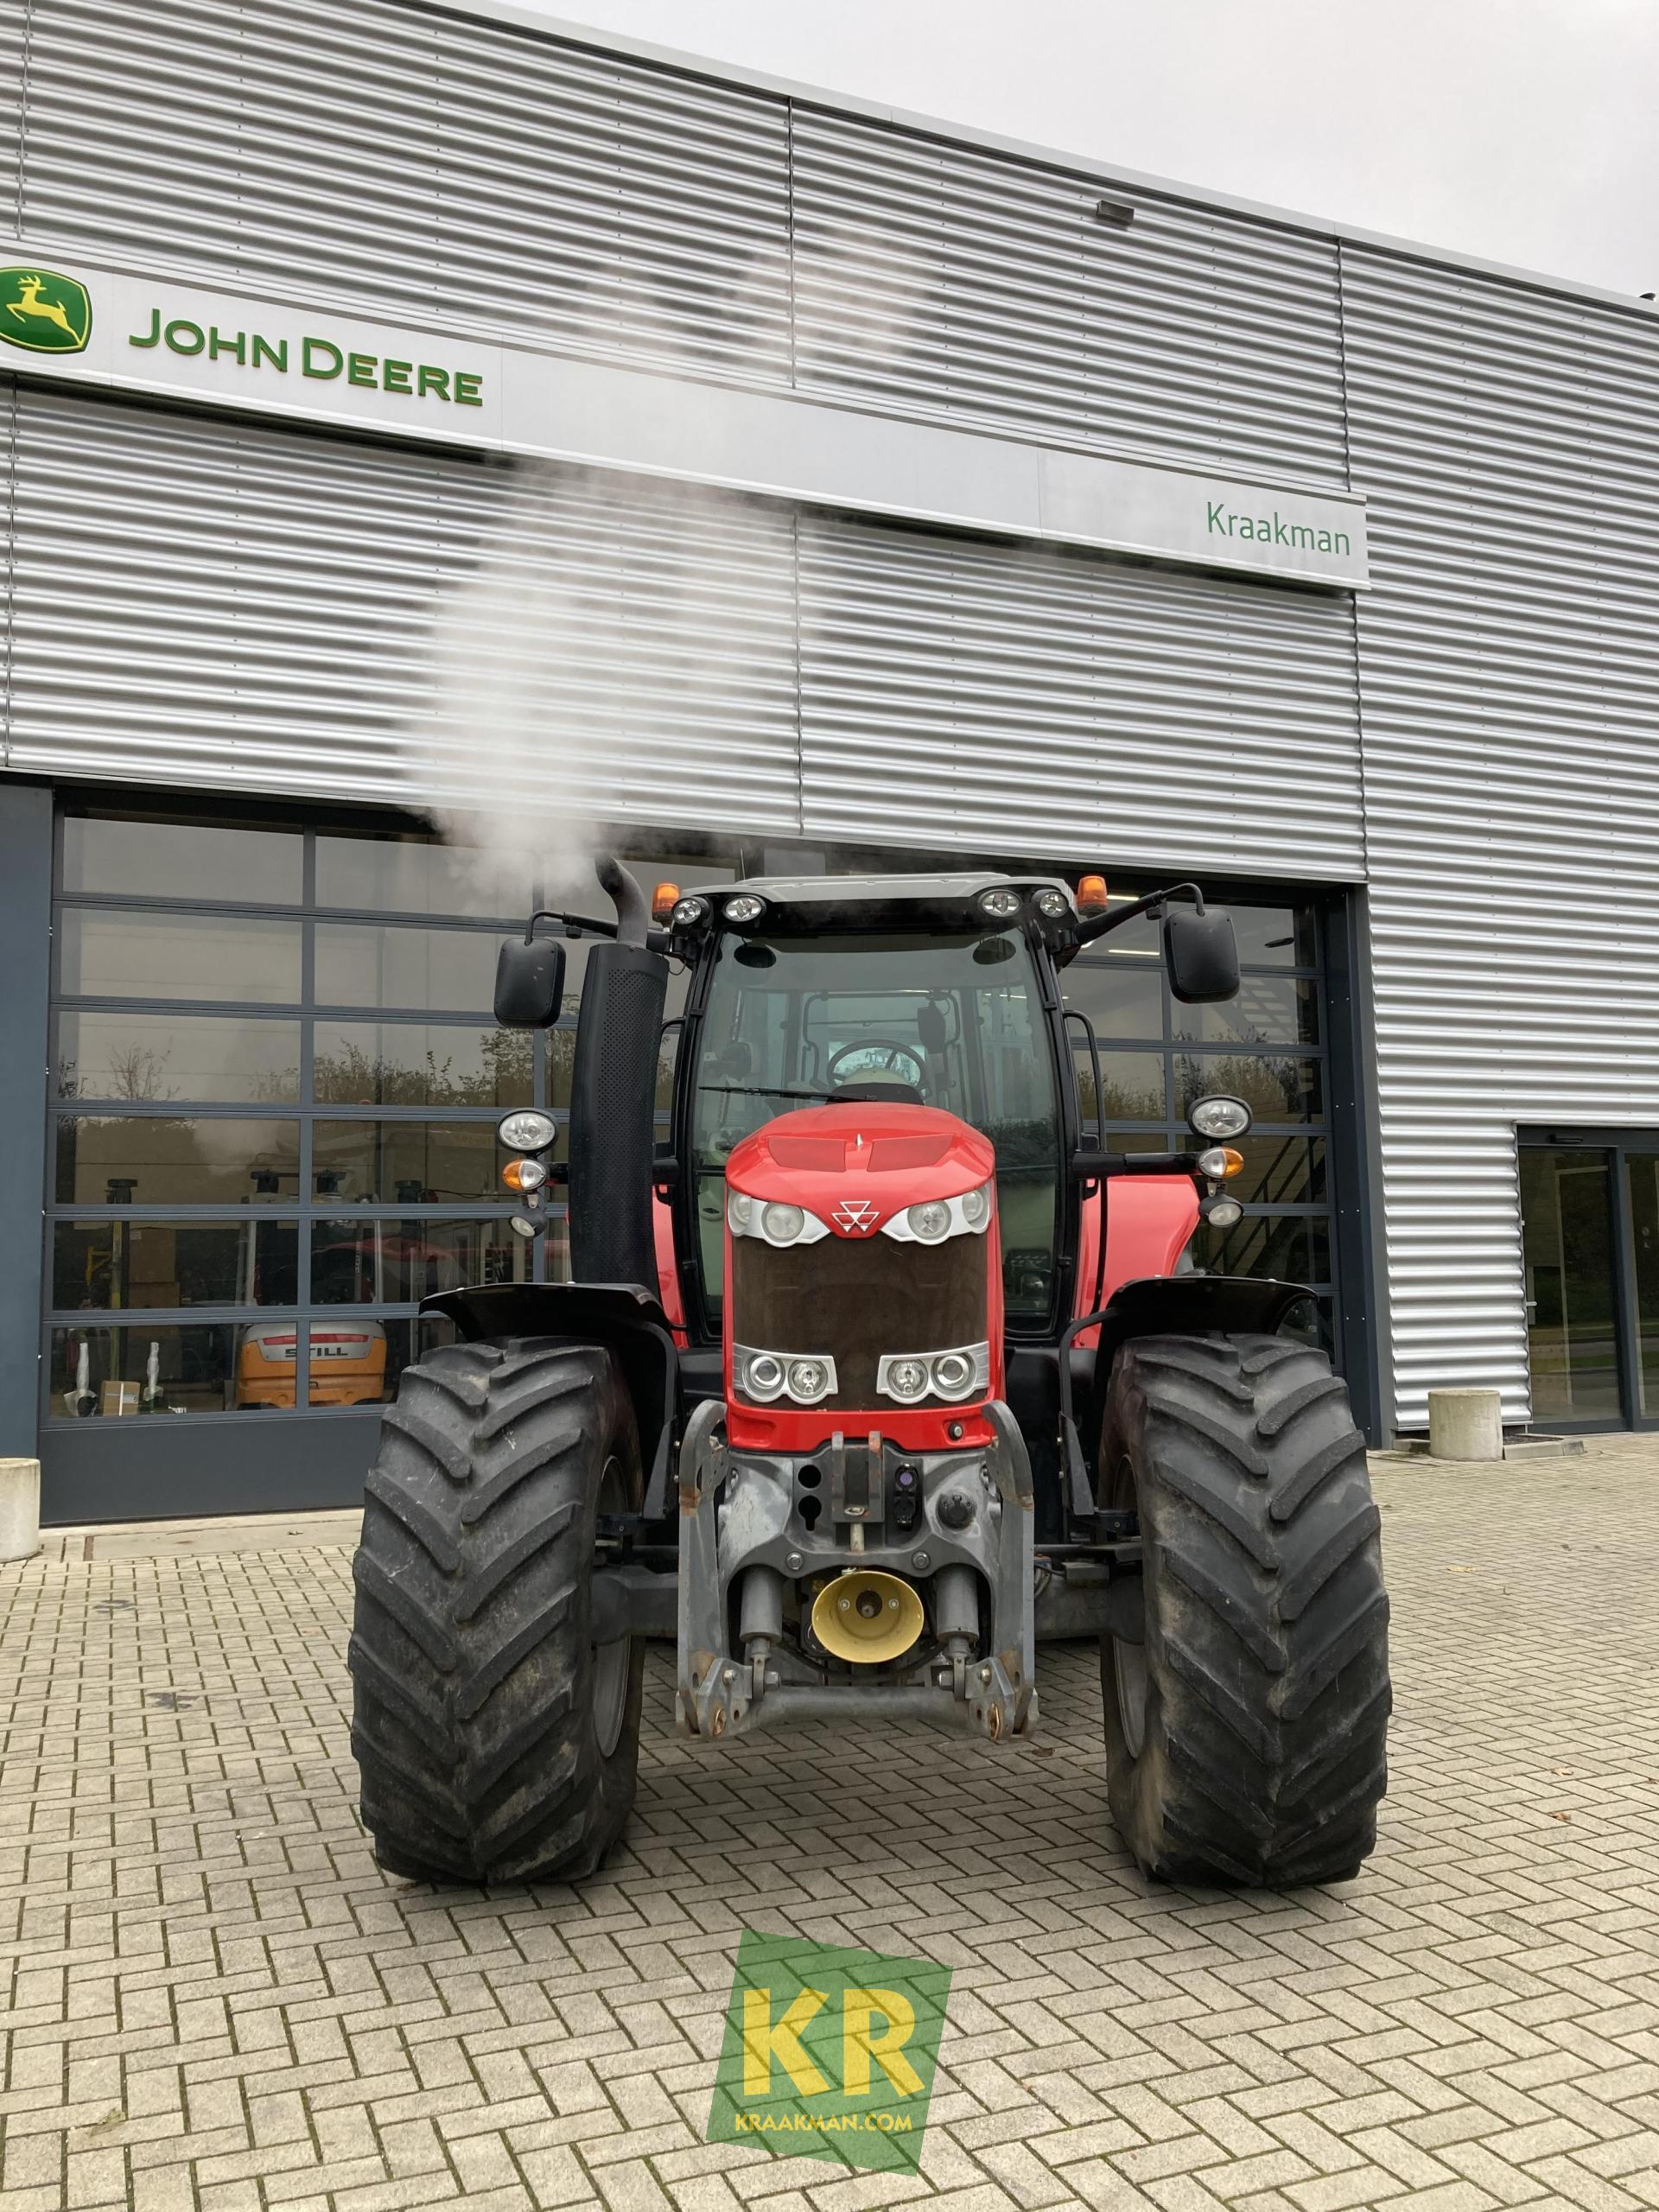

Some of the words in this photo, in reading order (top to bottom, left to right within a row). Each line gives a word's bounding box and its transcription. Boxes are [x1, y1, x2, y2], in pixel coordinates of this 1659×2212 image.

[129, 308, 288, 372] JOHN
[302, 336, 483, 406] DEERE
[1207, 501, 1350, 556] Kraakman
